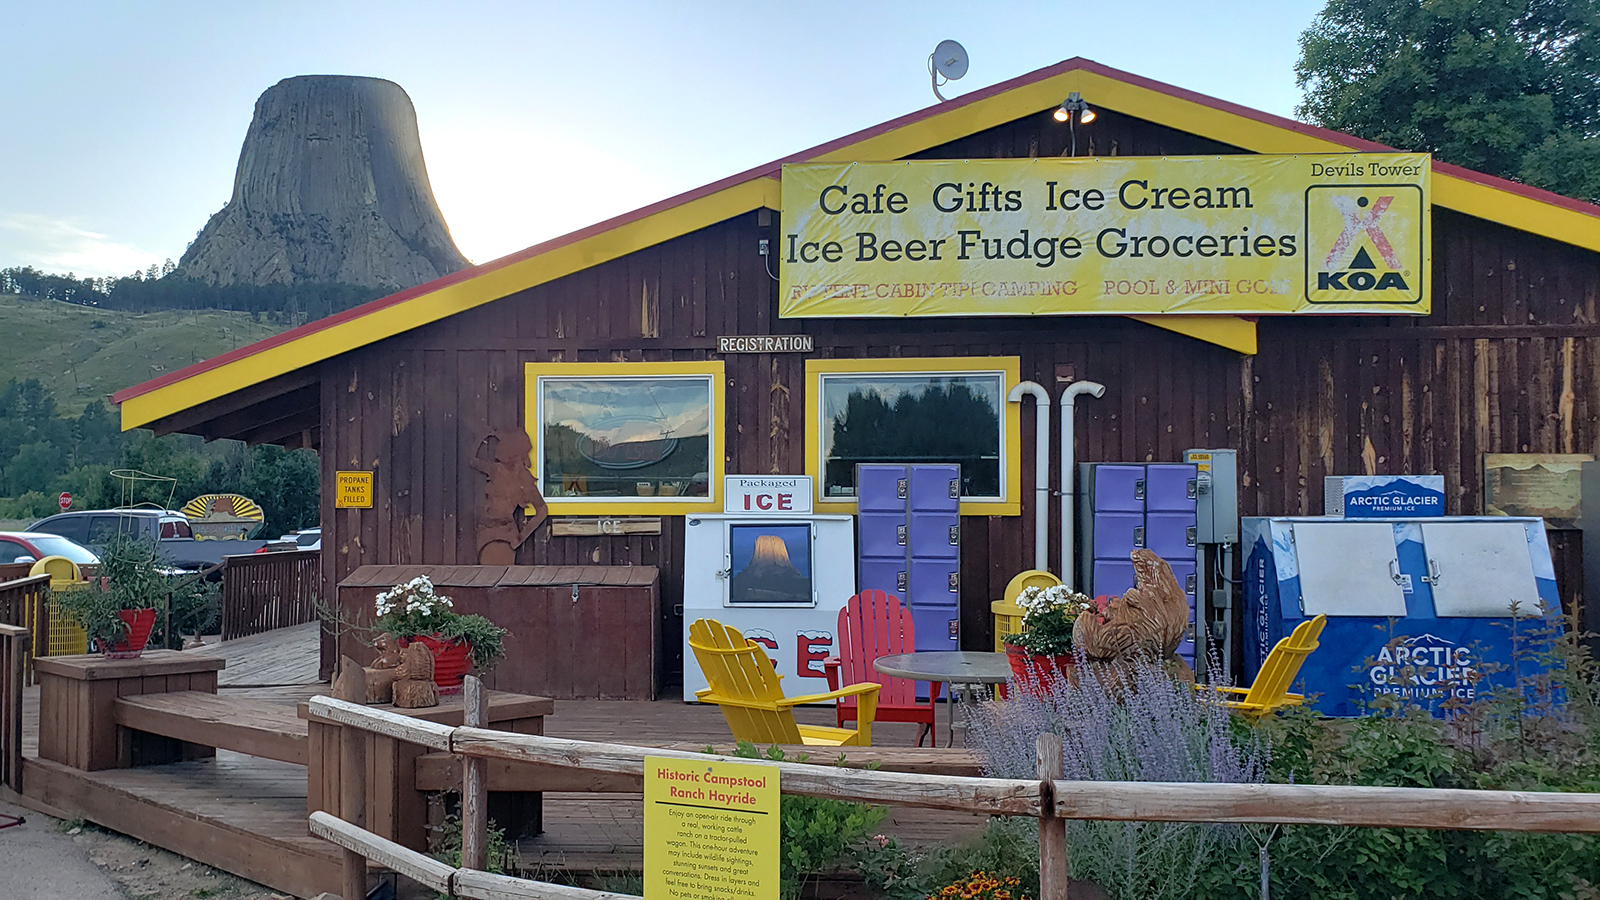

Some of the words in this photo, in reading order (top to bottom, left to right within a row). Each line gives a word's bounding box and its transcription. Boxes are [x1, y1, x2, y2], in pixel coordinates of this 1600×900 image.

[1311, 163, 1364, 176] Devils
[1368, 163, 1420, 176] Tower
[819, 184, 909, 215] Cafe
[932, 181, 1023, 213] Gifts
[1045, 181, 1105, 212] Ice
[1118, 179, 1254, 210] Cream
[786, 233, 843, 264] Ice
[855, 232, 946, 262] Beer
[956, 229, 1082, 268] Fudge
[1096, 226, 1297, 258] Groceries
[1318, 271, 1410, 291] KOA
[875, 283, 936, 298] CABIN
[939, 282, 979, 297] TIPI
[981, 280, 1078, 297] CAMPING
[1103, 280, 1160, 295] POOL
[1165, 280, 1178, 295] &
[1184, 280, 1230, 295] MINI
[720, 336, 812, 351] REGISTRATION
[740, 479, 797, 488] Packaged
[744, 492, 793, 510] ICE
[1350, 496, 1390, 505] ARCTIC
[1392, 496, 1438, 505] GLACIER
[597, 519, 621, 534] ICE
[1377, 646, 1471, 666] ARCTIC
[1451, 688, 1474, 699] ICE
[657, 768, 700, 783] Historic
[703, 772, 766, 788] Campstool
[670, 786, 705, 800] Ranch
[709, 790, 756, 805] Hayride
[668, 809, 684, 819] Enjoy
[695, 812, 719, 820] open-air
[733, 816, 756, 826] through
[702, 823, 725, 833] working
[709, 834, 747, 844] tractor-pulled
[668, 850, 680, 858] may
[682, 850, 702, 860] include
[704, 852, 725, 862] wildlife
[702, 844, 728, 852] one-hour
[728, 846, 758, 856] adventure
[673, 860, 696, 870] stunning
[698, 863, 718, 872] sunsets
[720, 865, 731, 874] and
[733, 868, 749, 876] great
[665, 877, 676, 886] feel
[677, 879, 689, 887] free
[690, 881, 695, 889] to
[697, 883, 712, 893] bring
[704, 873, 720, 882] Dress
[722, 875, 727, 883] in
[729, 875, 746, 886] layers
[748, 879, 759, 887] and
[669, 888, 679, 896] No
[680, 889, 692, 898] pets
